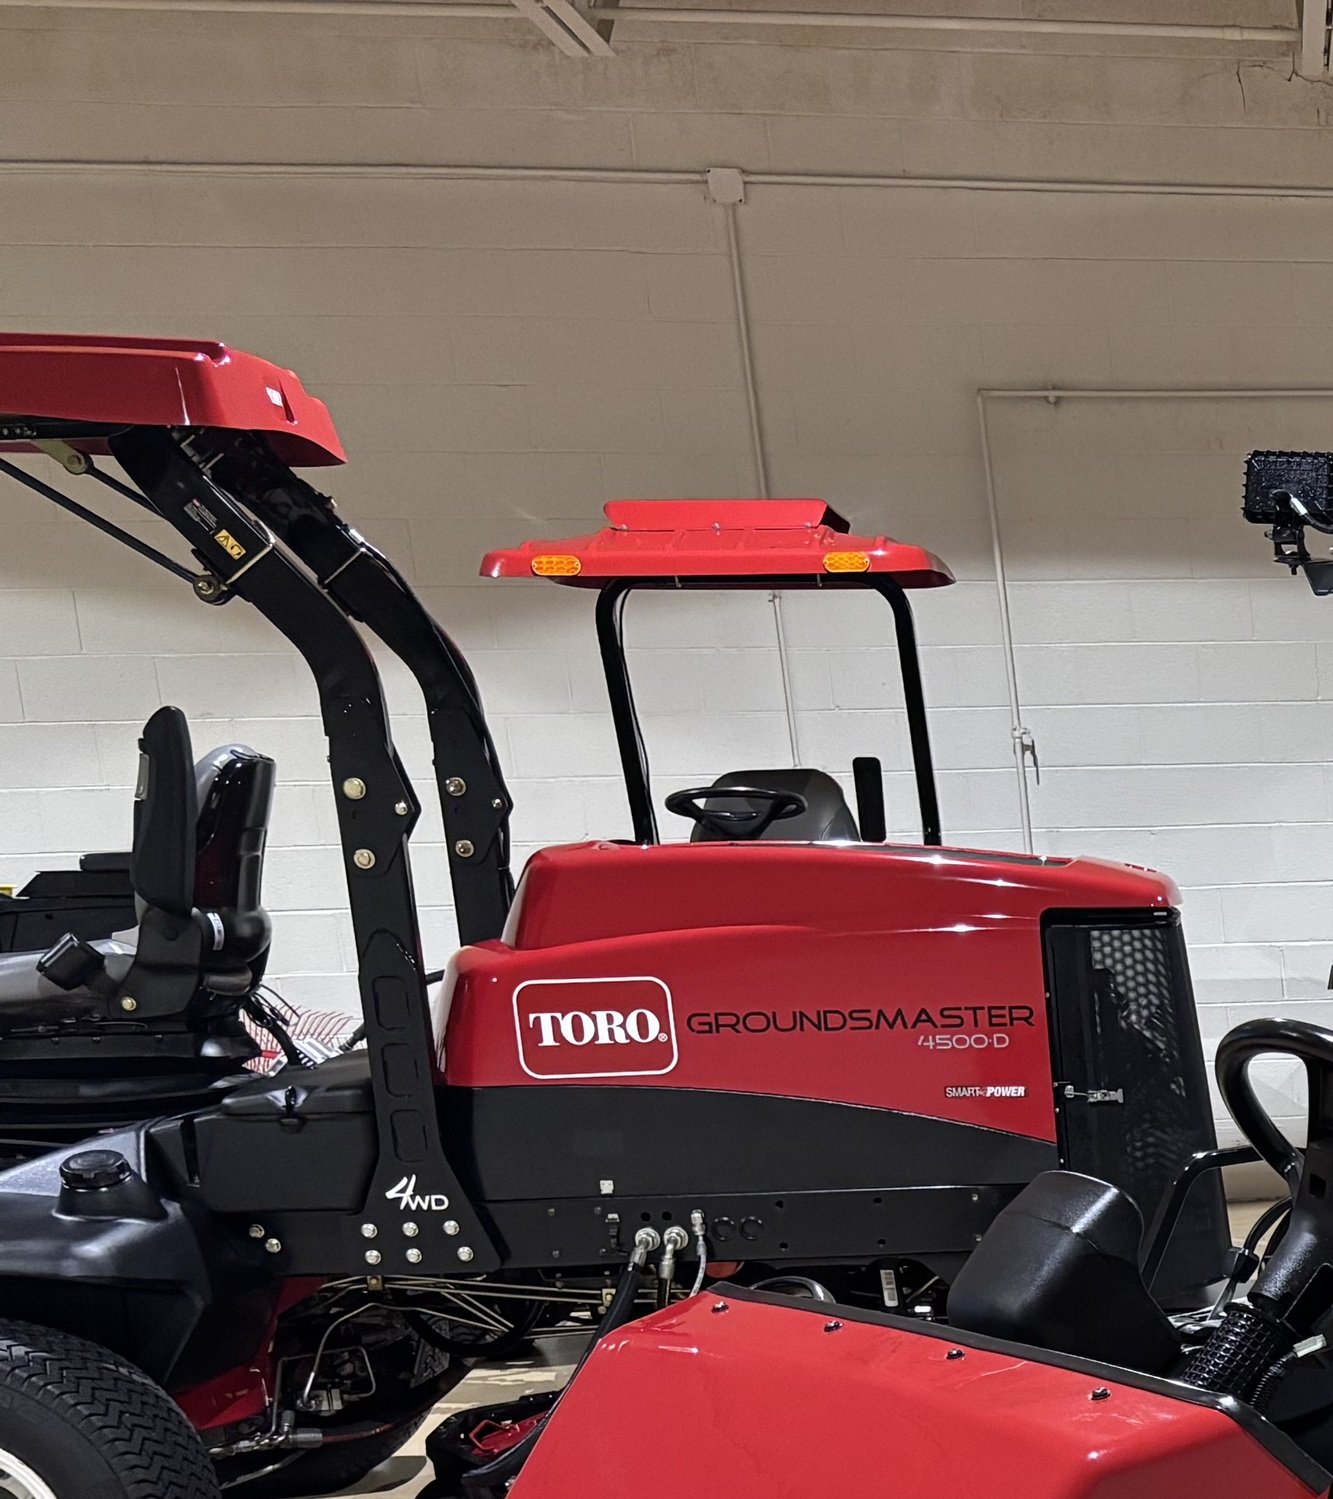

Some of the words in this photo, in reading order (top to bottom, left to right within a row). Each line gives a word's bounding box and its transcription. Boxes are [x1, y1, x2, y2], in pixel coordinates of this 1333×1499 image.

[528, 1008, 660, 1047] TORO
[686, 1005, 1035, 1036] GROUNDSMASTER
[985, 1086, 1025, 1098] POWER
[385, 1173, 449, 1211] 4WD
